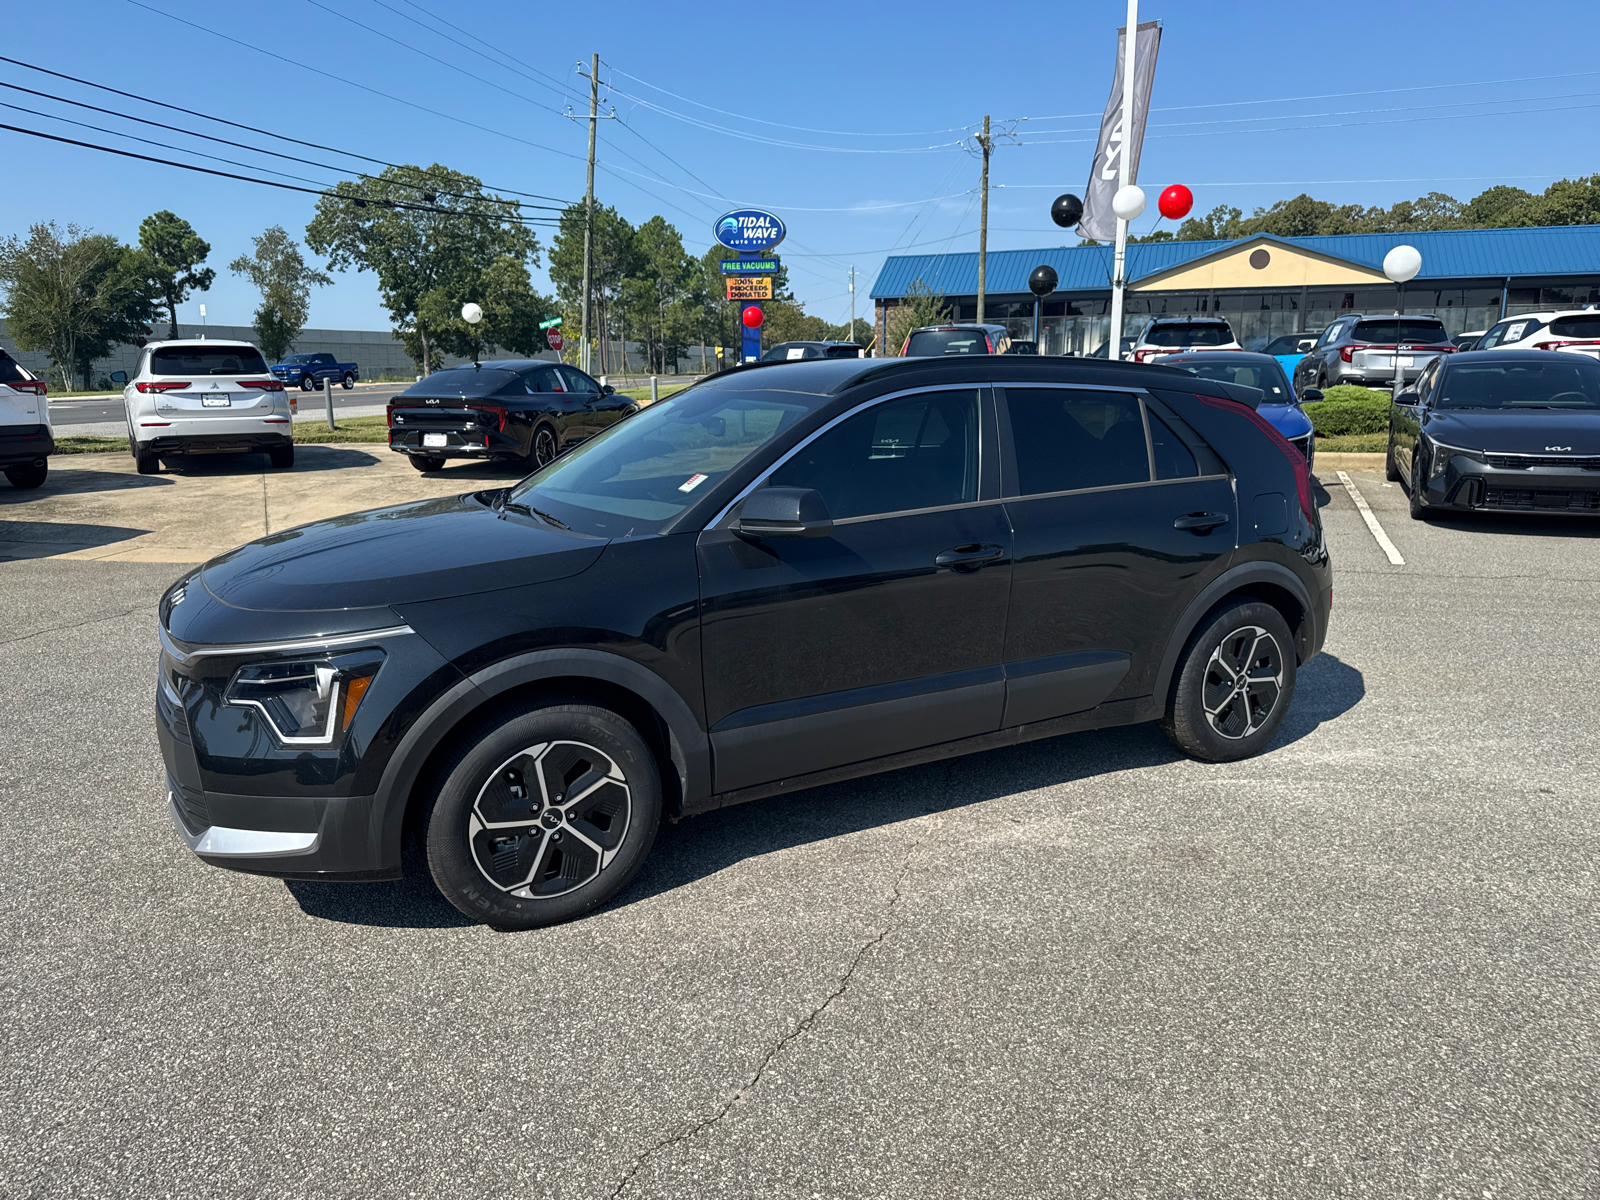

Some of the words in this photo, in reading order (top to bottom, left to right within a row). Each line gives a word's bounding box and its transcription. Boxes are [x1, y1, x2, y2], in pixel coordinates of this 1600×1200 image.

[738, 216, 771, 227] TIDAL
[743, 228, 778, 239] WAVE
[722, 262, 741, 270] FREE
[742, 261, 776, 270] VACUUMS
[548, 334, 562, 344] STOP
[461, 883, 541, 922] NEXEN
